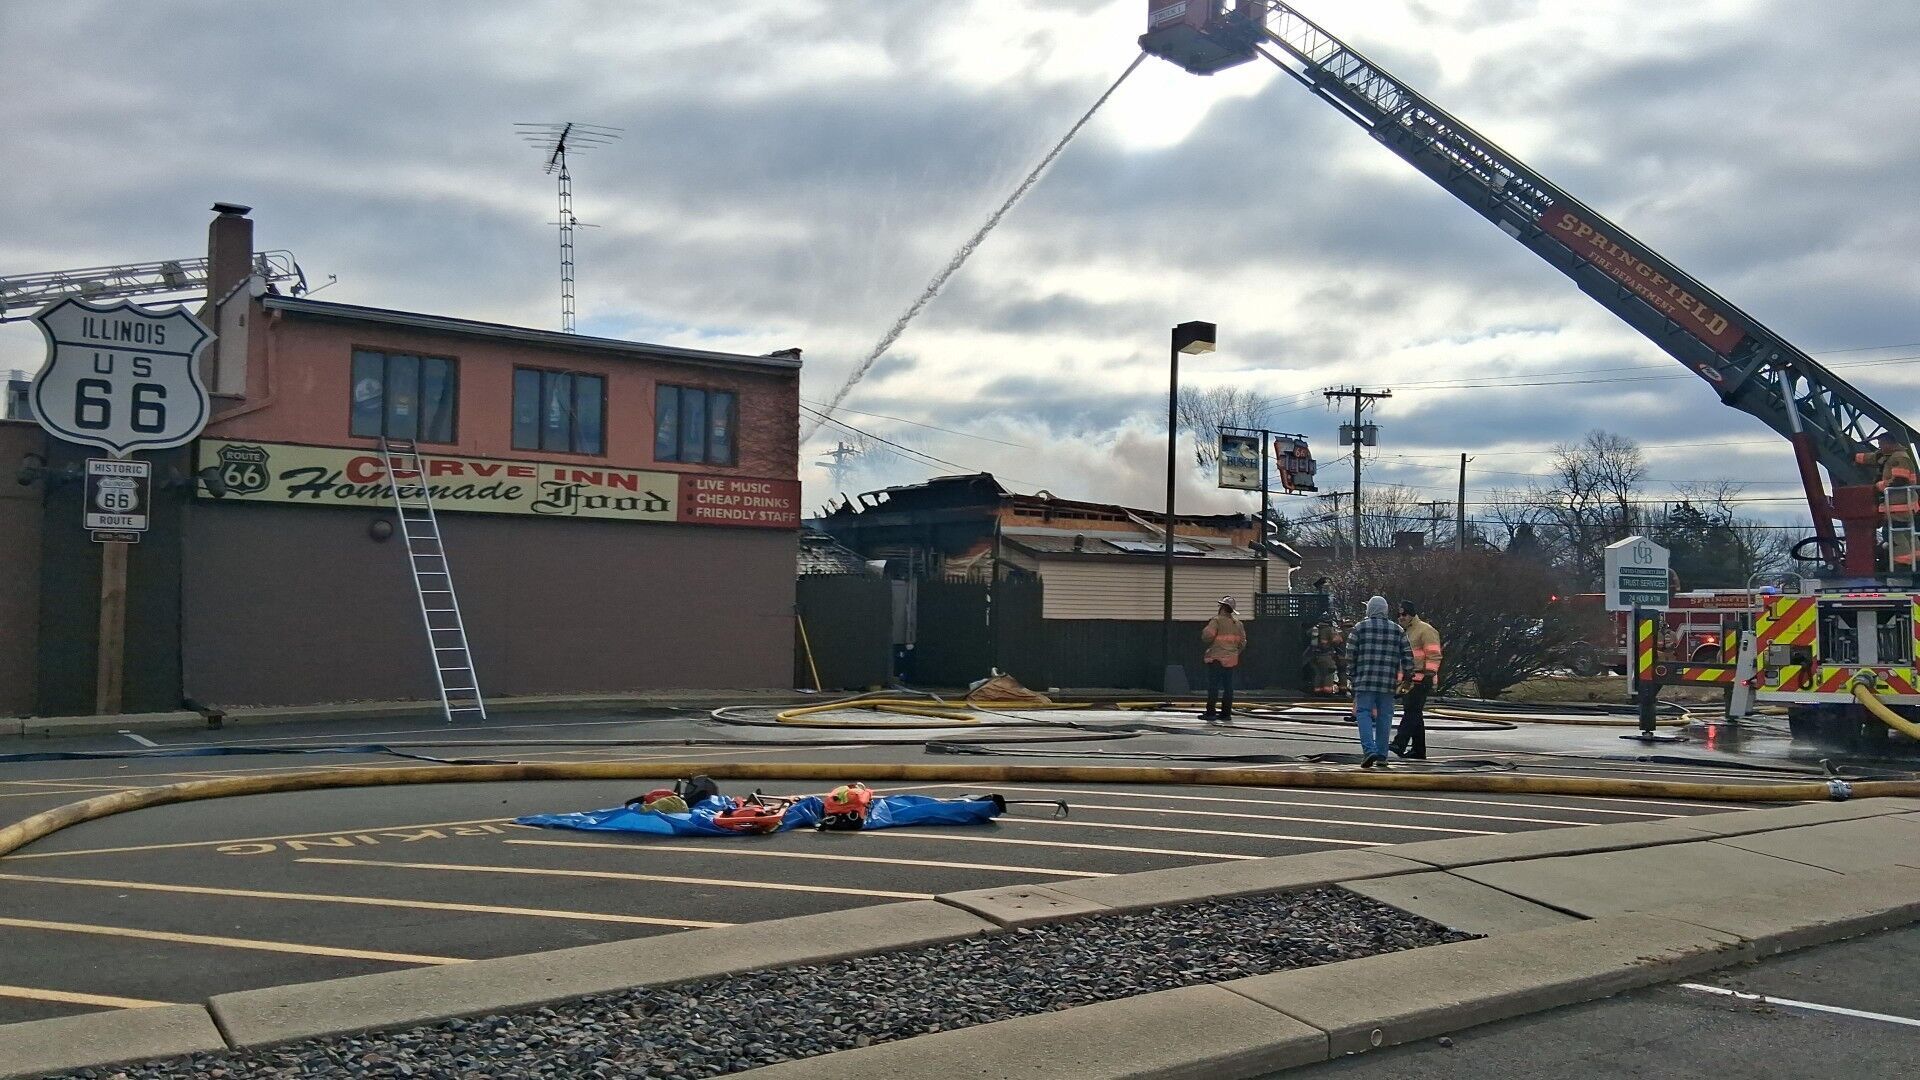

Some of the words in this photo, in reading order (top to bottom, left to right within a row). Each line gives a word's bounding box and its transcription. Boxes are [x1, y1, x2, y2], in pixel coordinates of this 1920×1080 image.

[1557, 213, 1728, 336] SPRINGFIELD
[1589, 251, 1611, 270] FIRE
[1612, 266, 1676, 314] DEPARTMENT
[83, 317, 165, 345] ILLINOIS
[75, 378, 167, 434] 66
[226, 451, 260, 462] ROUTE
[1227, 455, 1258, 469] BUSCH
[95, 464, 142, 474] HISTORIC
[224, 463, 260, 487] 66
[346, 456, 537, 483] CURVE
[554, 469, 638, 491] INN
[280, 467, 523, 500] Homemade
[531, 481, 671, 515] Food
[697, 480, 724, 490] LIVE
[731, 482, 771, 493] MUSIC
[105, 493, 129, 508] 66
[697, 493, 740, 506] CHEAP
[744, 496, 790, 508] DRINKS
[100, 516, 133, 525] ROUTE
[696, 507, 758, 520] FRIENDLY
[760, 510, 796, 521] STAFF
[1766, 602, 1780, 621] 1
